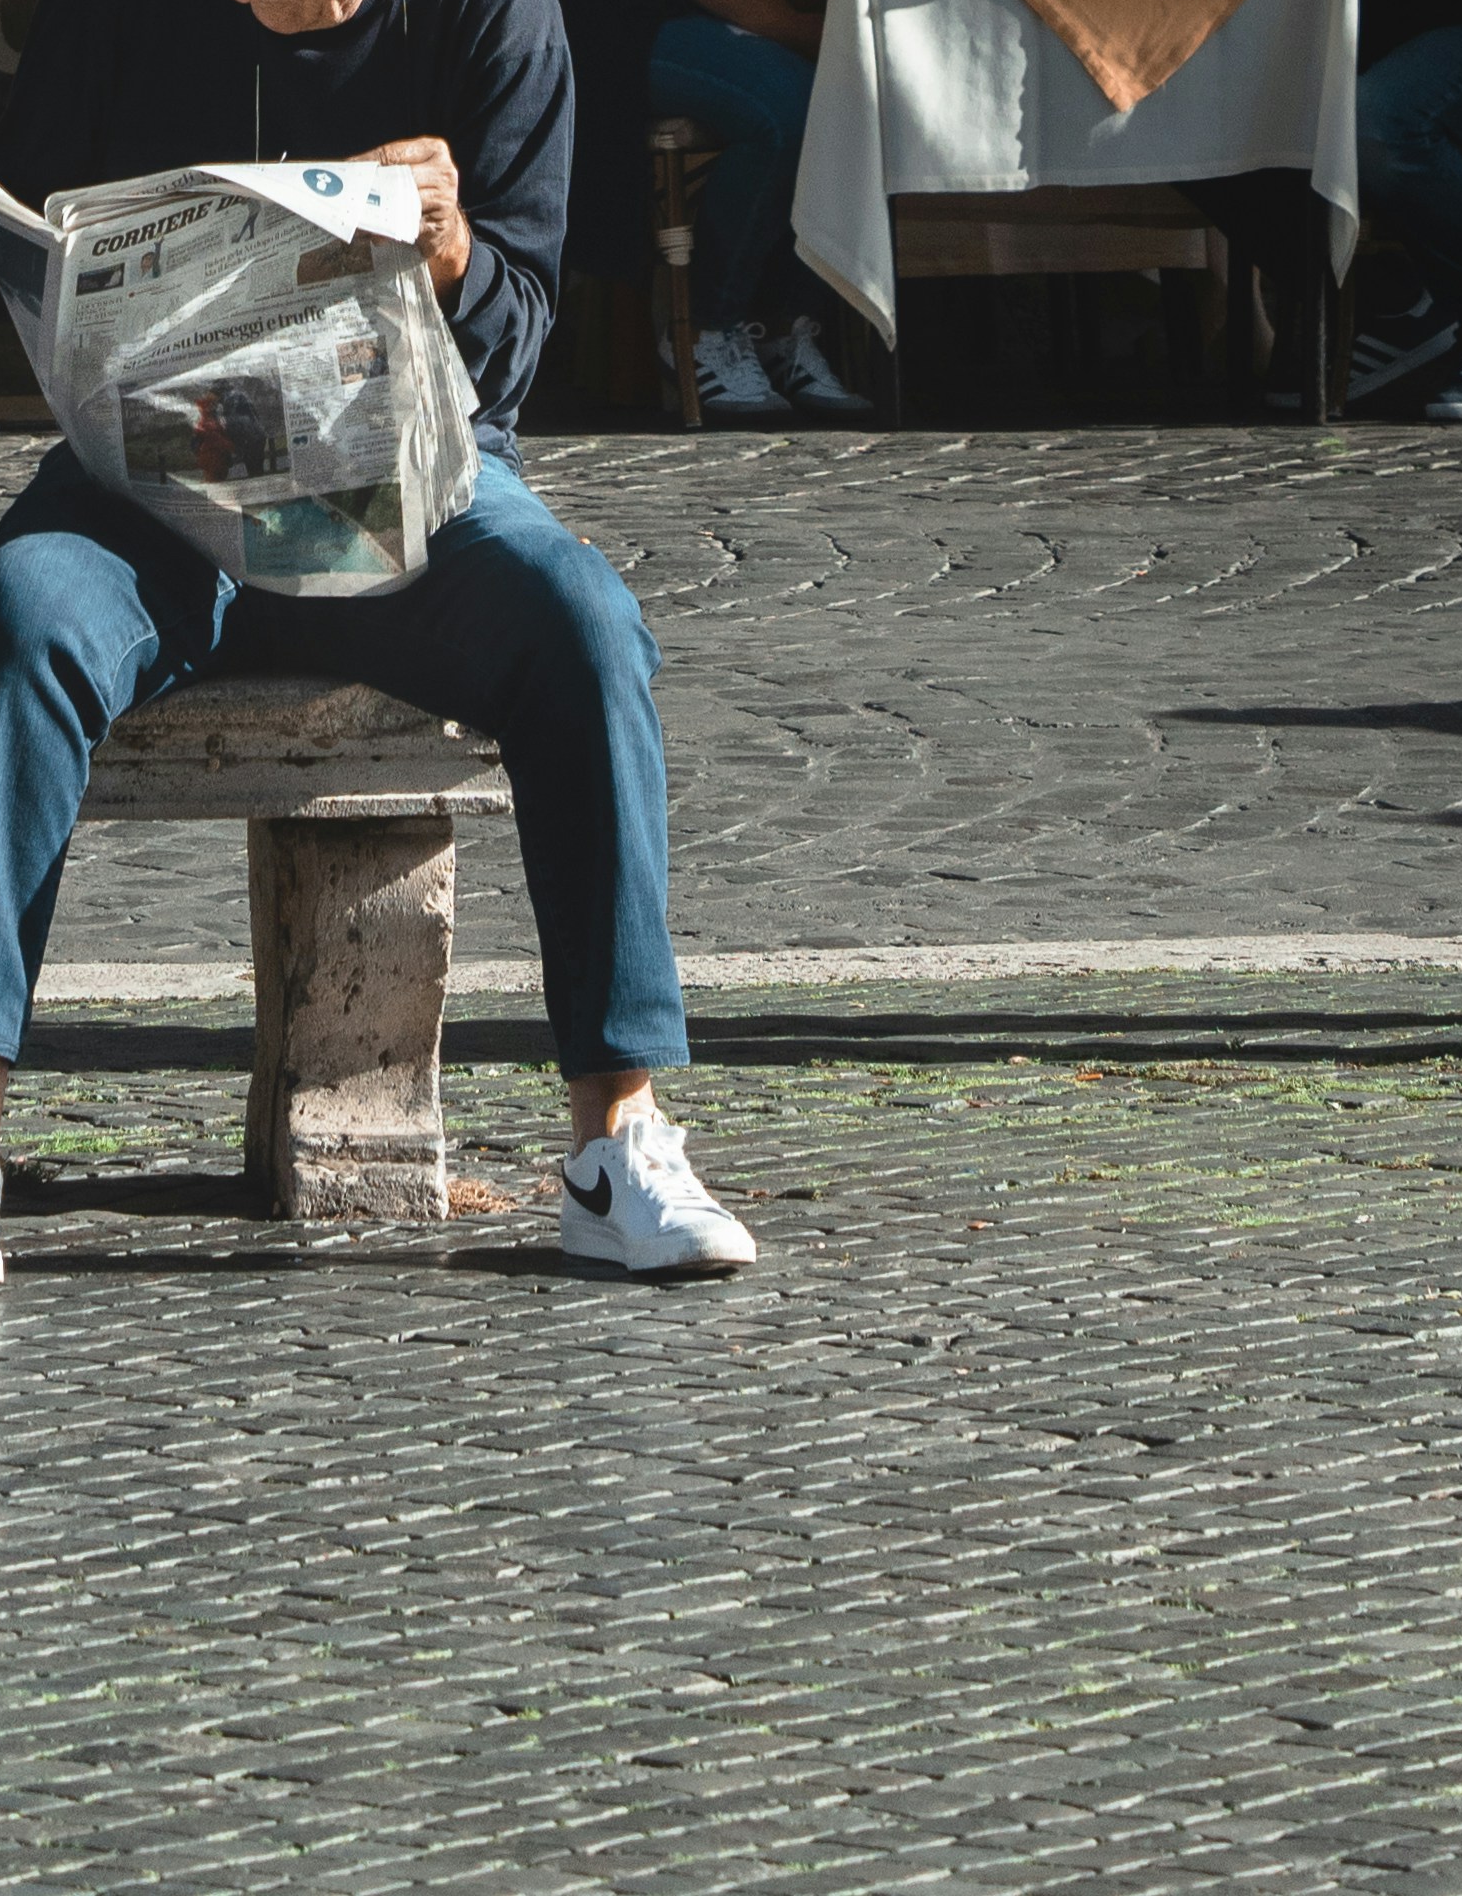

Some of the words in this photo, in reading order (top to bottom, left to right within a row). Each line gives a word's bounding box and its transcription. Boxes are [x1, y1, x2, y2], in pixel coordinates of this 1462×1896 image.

[91, 200, 214, 257] CORRIERE
[173, 337, 192, 350] su
[193, 315, 264, 346] borseggi
[266, 318, 277, 330] e
[278, 305, 326, 328] truffe
